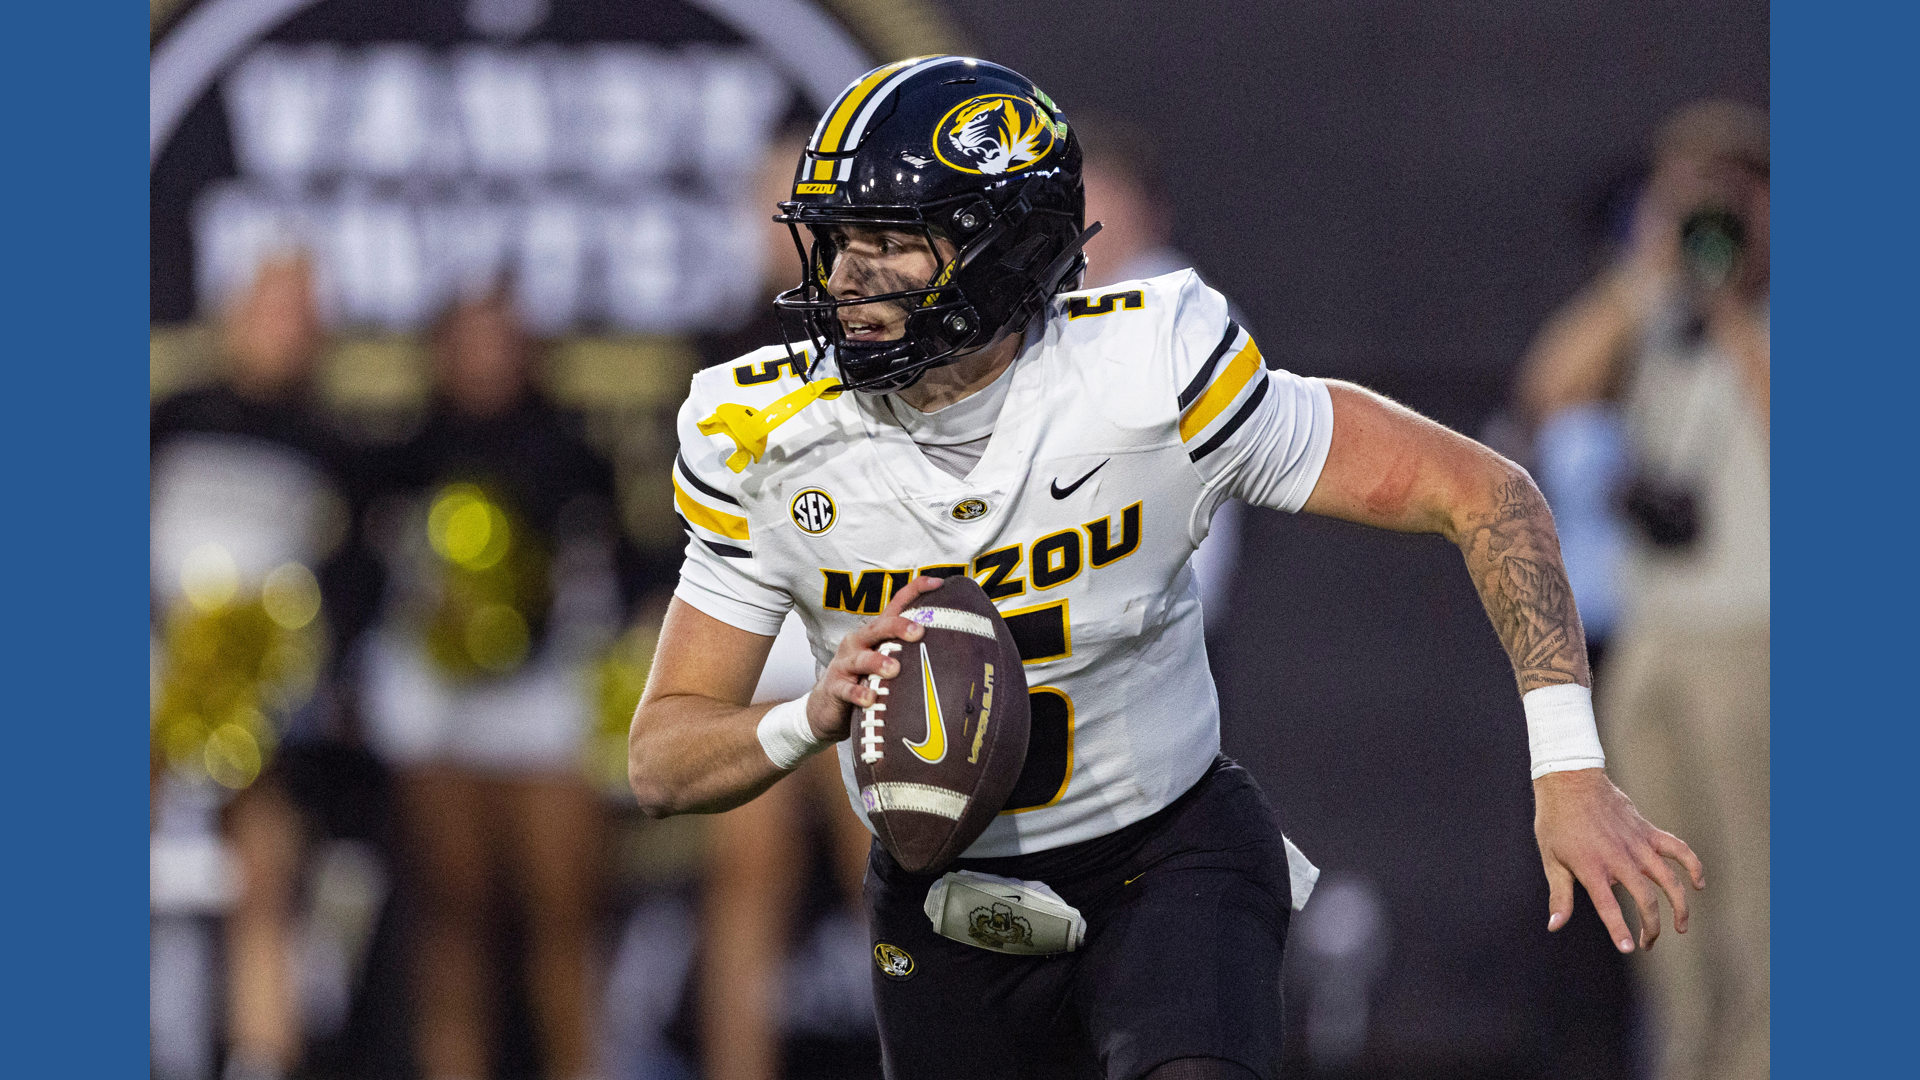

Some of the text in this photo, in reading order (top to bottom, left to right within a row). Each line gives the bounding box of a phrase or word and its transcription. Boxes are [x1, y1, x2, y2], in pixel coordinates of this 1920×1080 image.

[796, 183, 837, 195] MIZZOU
[1068, 289, 1145, 321] 5
[733, 349, 810, 387] 5
[793, 492, 833, 531] SEC
[819, 499, 1143, 617] MIZOU
